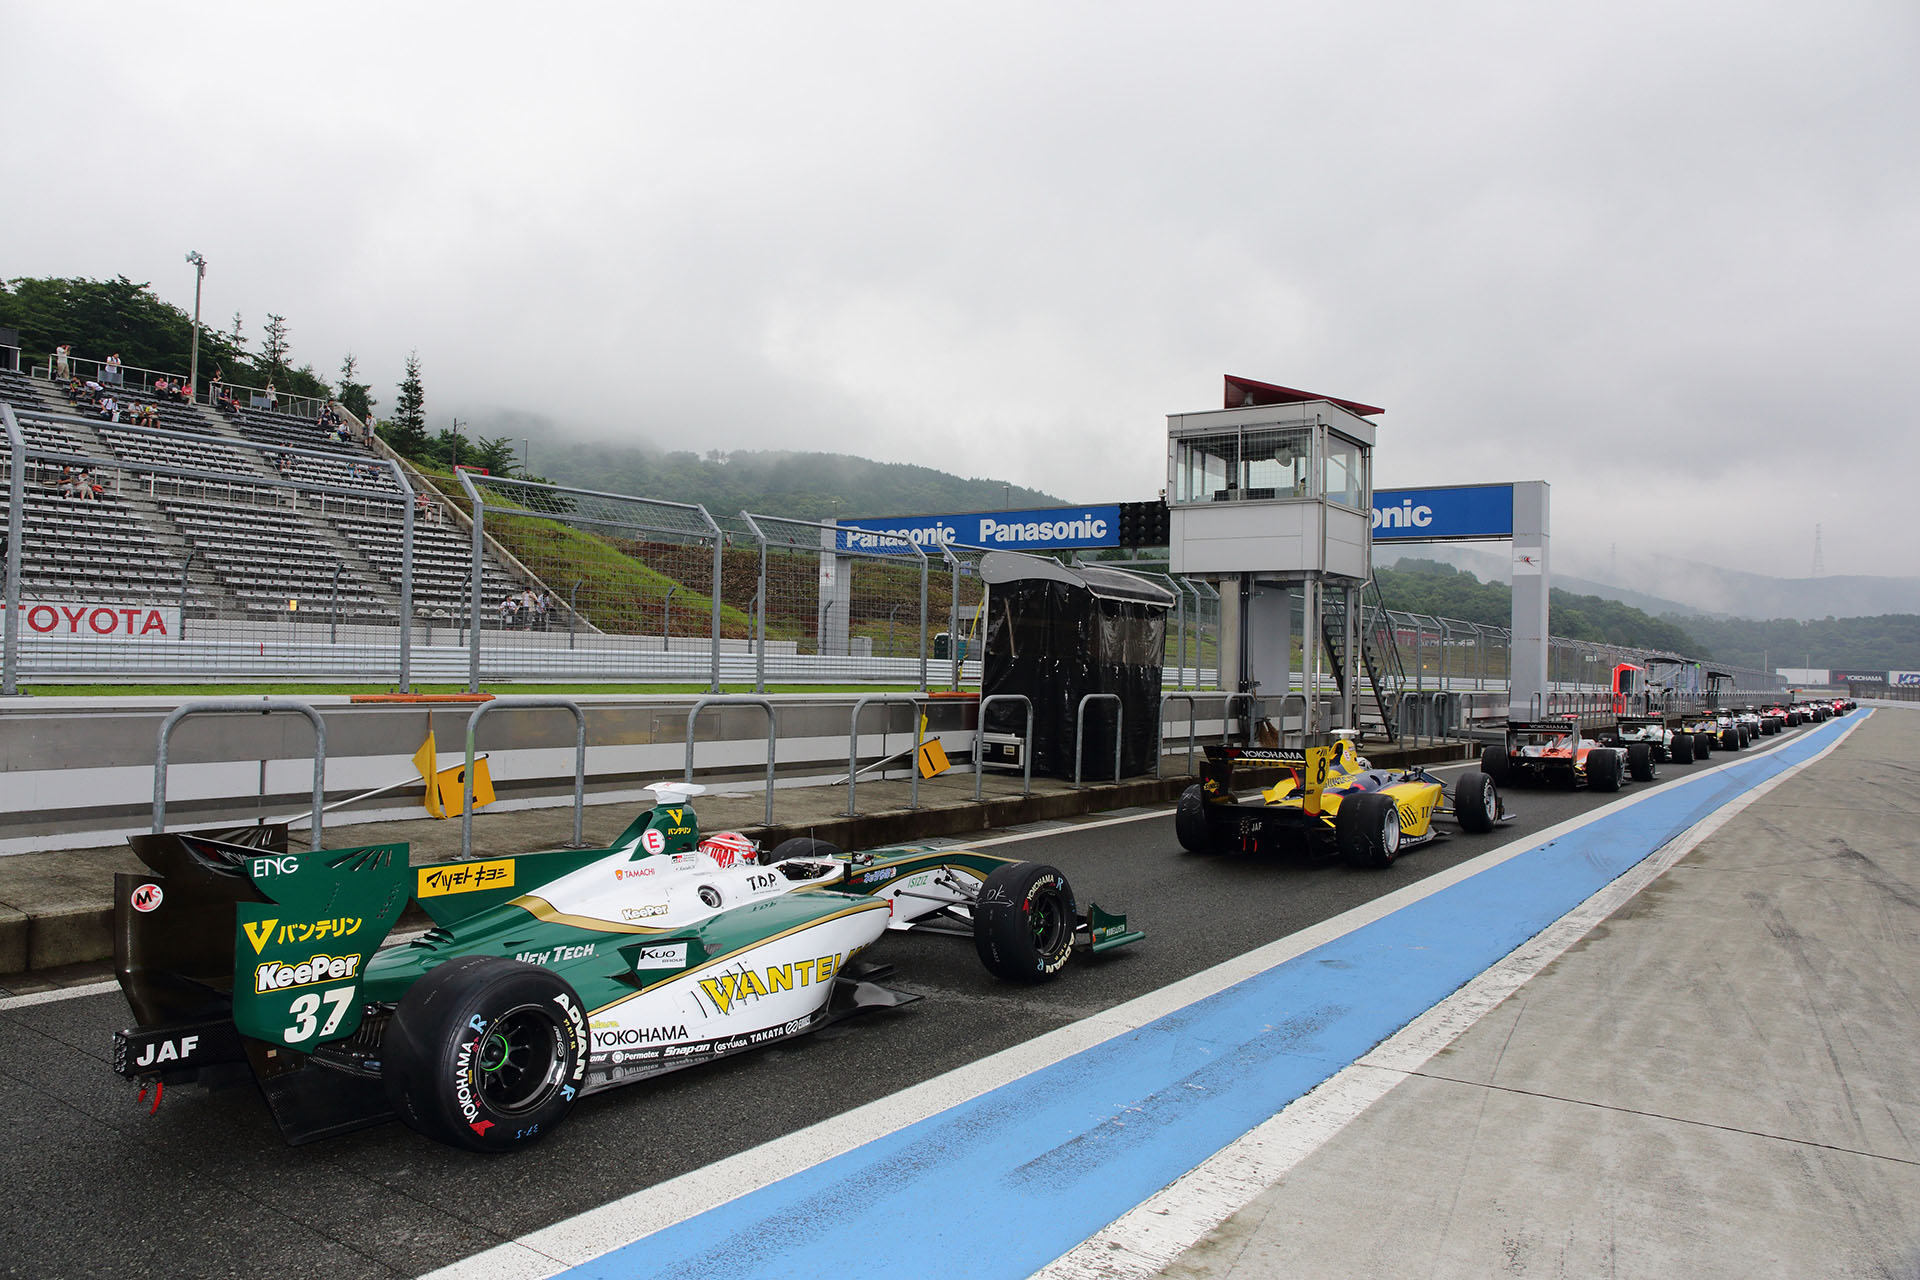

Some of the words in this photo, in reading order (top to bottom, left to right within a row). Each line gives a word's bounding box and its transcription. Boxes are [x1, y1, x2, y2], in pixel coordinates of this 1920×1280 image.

[1372, 499, 1433, 529] onic
[846, 521, 957, 548] Panasonic
[979, 514, 1107, 543] Panasonic
[0, 604, 168, 635] OYOTA
[1241, 750, 1305, 760] YOKOHAMA
[1317, 756, 1326, 785] 8
[647, 832, 660, 849] E
[667, 827, 692, 836] バンテリン
[1251, 822, 1262, 832] JAF
[253, 856, 299, 878] ENG
[624, 868, 656, 879] TAMACHI
[1027, 874, 1055, 901] YOKOHAMA
[621, 904, 669, 921] KeePer
[277, 917, 363, 945] バンテリン
[256, 954, 361, 994] KeePer
[699, 943, 870, 1015] VANTEL
[283, 985, 356, 1044] 37
[468, 1012, 488, 1035] R
[553, 992, 587, 1080] ADVAN
[589, 1053, 608, 1063] ond
[624, 1051, 660, 1061] Permatex
[663, 1042, 710, 1058] Snap-on
[750, 1026, 784, 1043] TAKATA
[594, 1024, 689, 1047] YOKOHAMA
[136, 1035, 199, 1067] JAF
[456, 1041, 479, 1124] YOKOHAMA
[560, 1083, 576, 1102] R
